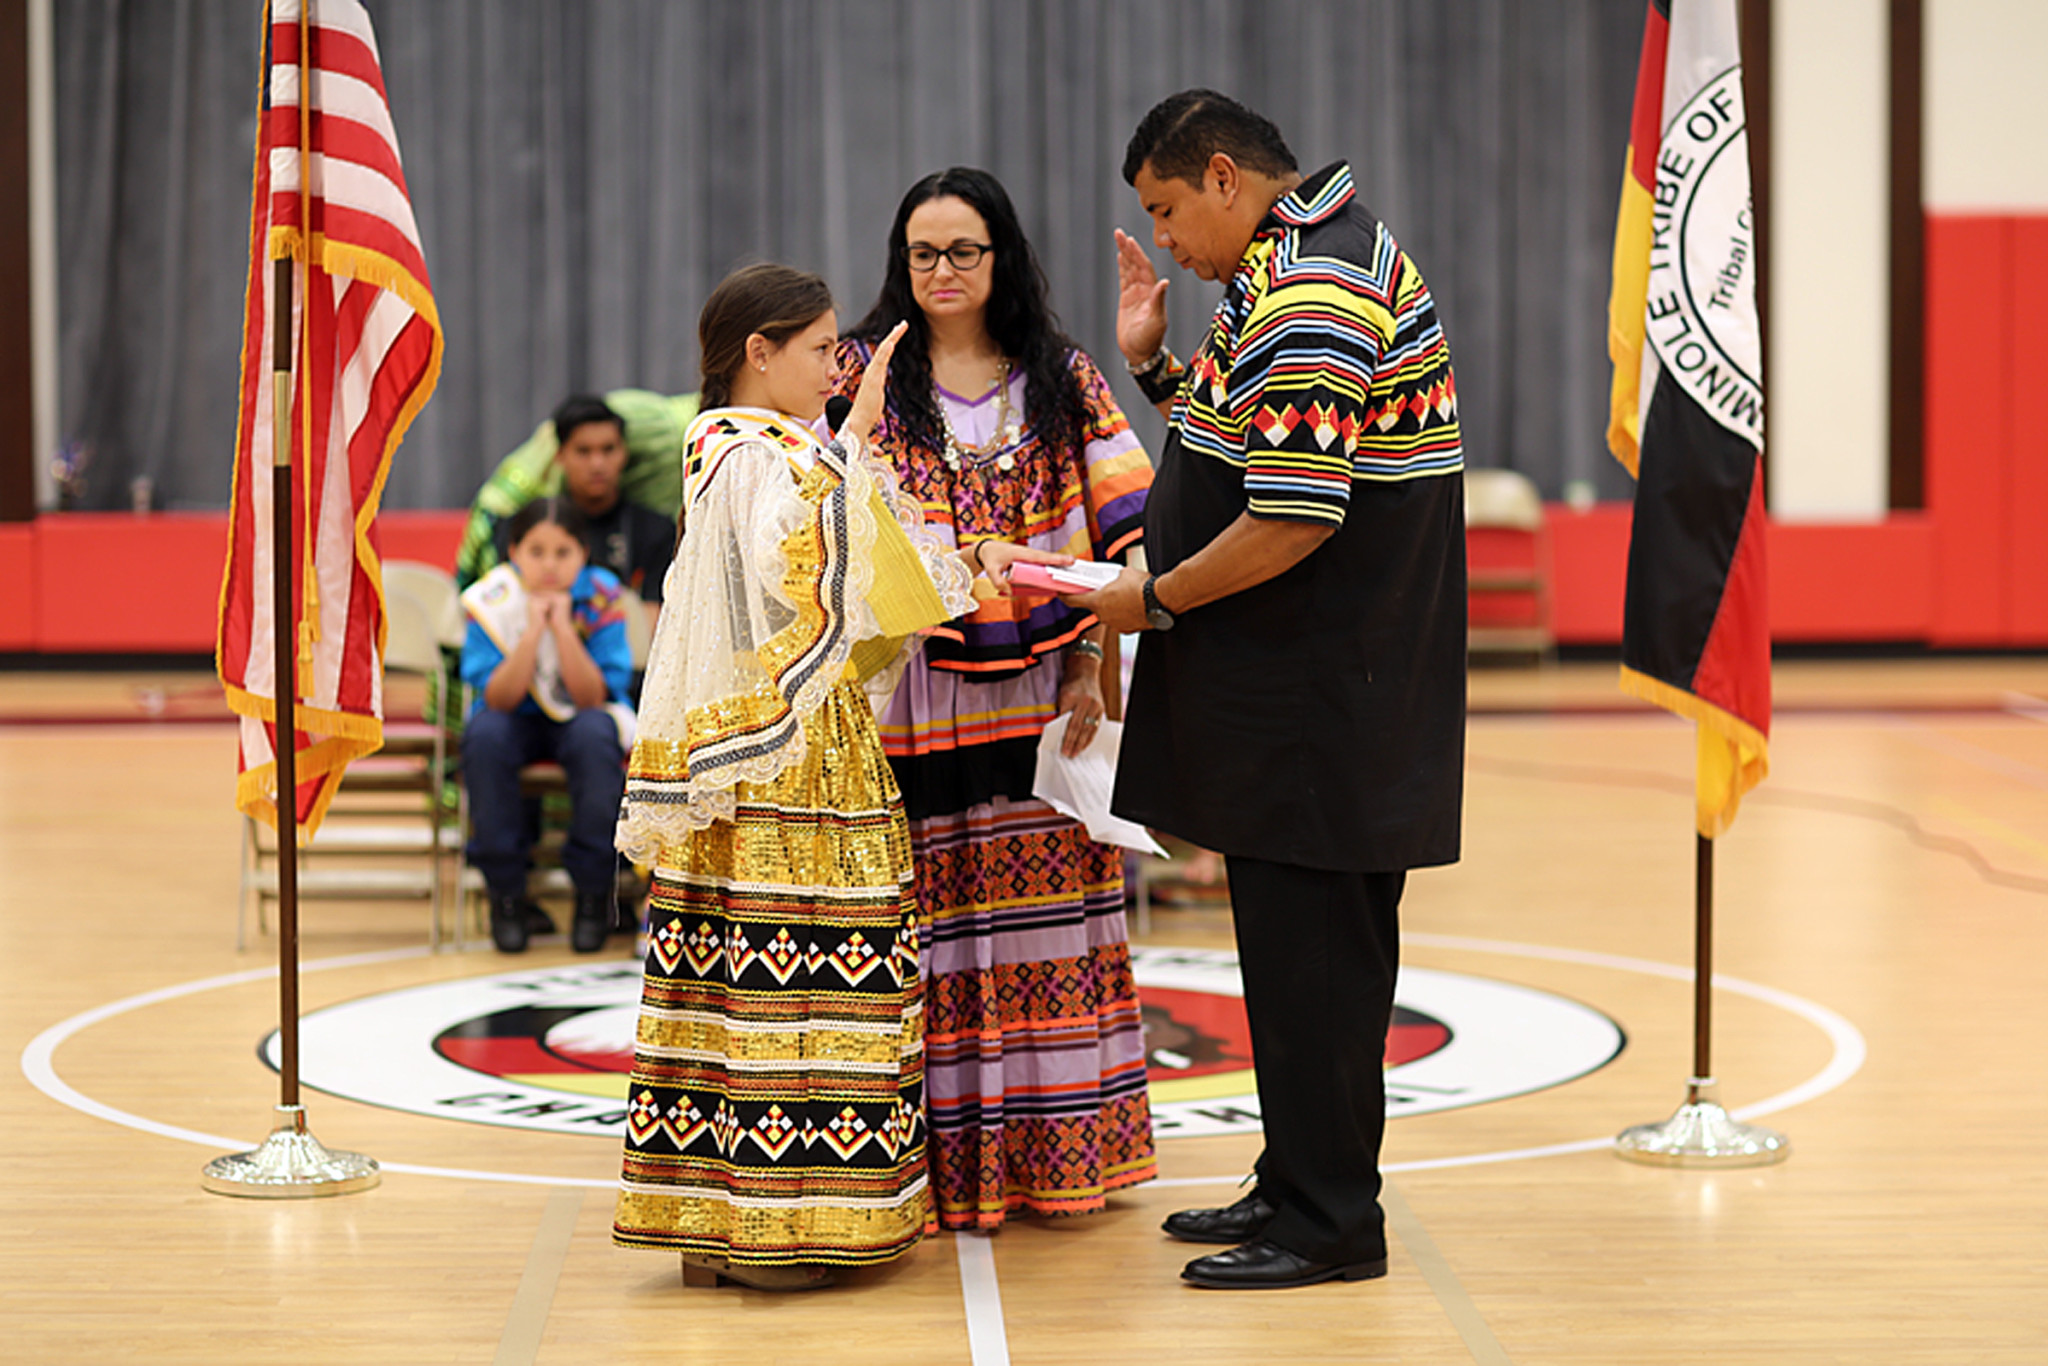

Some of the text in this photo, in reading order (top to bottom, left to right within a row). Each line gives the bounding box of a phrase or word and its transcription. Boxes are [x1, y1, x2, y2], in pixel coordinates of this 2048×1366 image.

[1686, 87, 1733, 141] OF
[1707, 236, 1748, 309] Tribal
[1648, 290, 1762, 435] MINOLE
